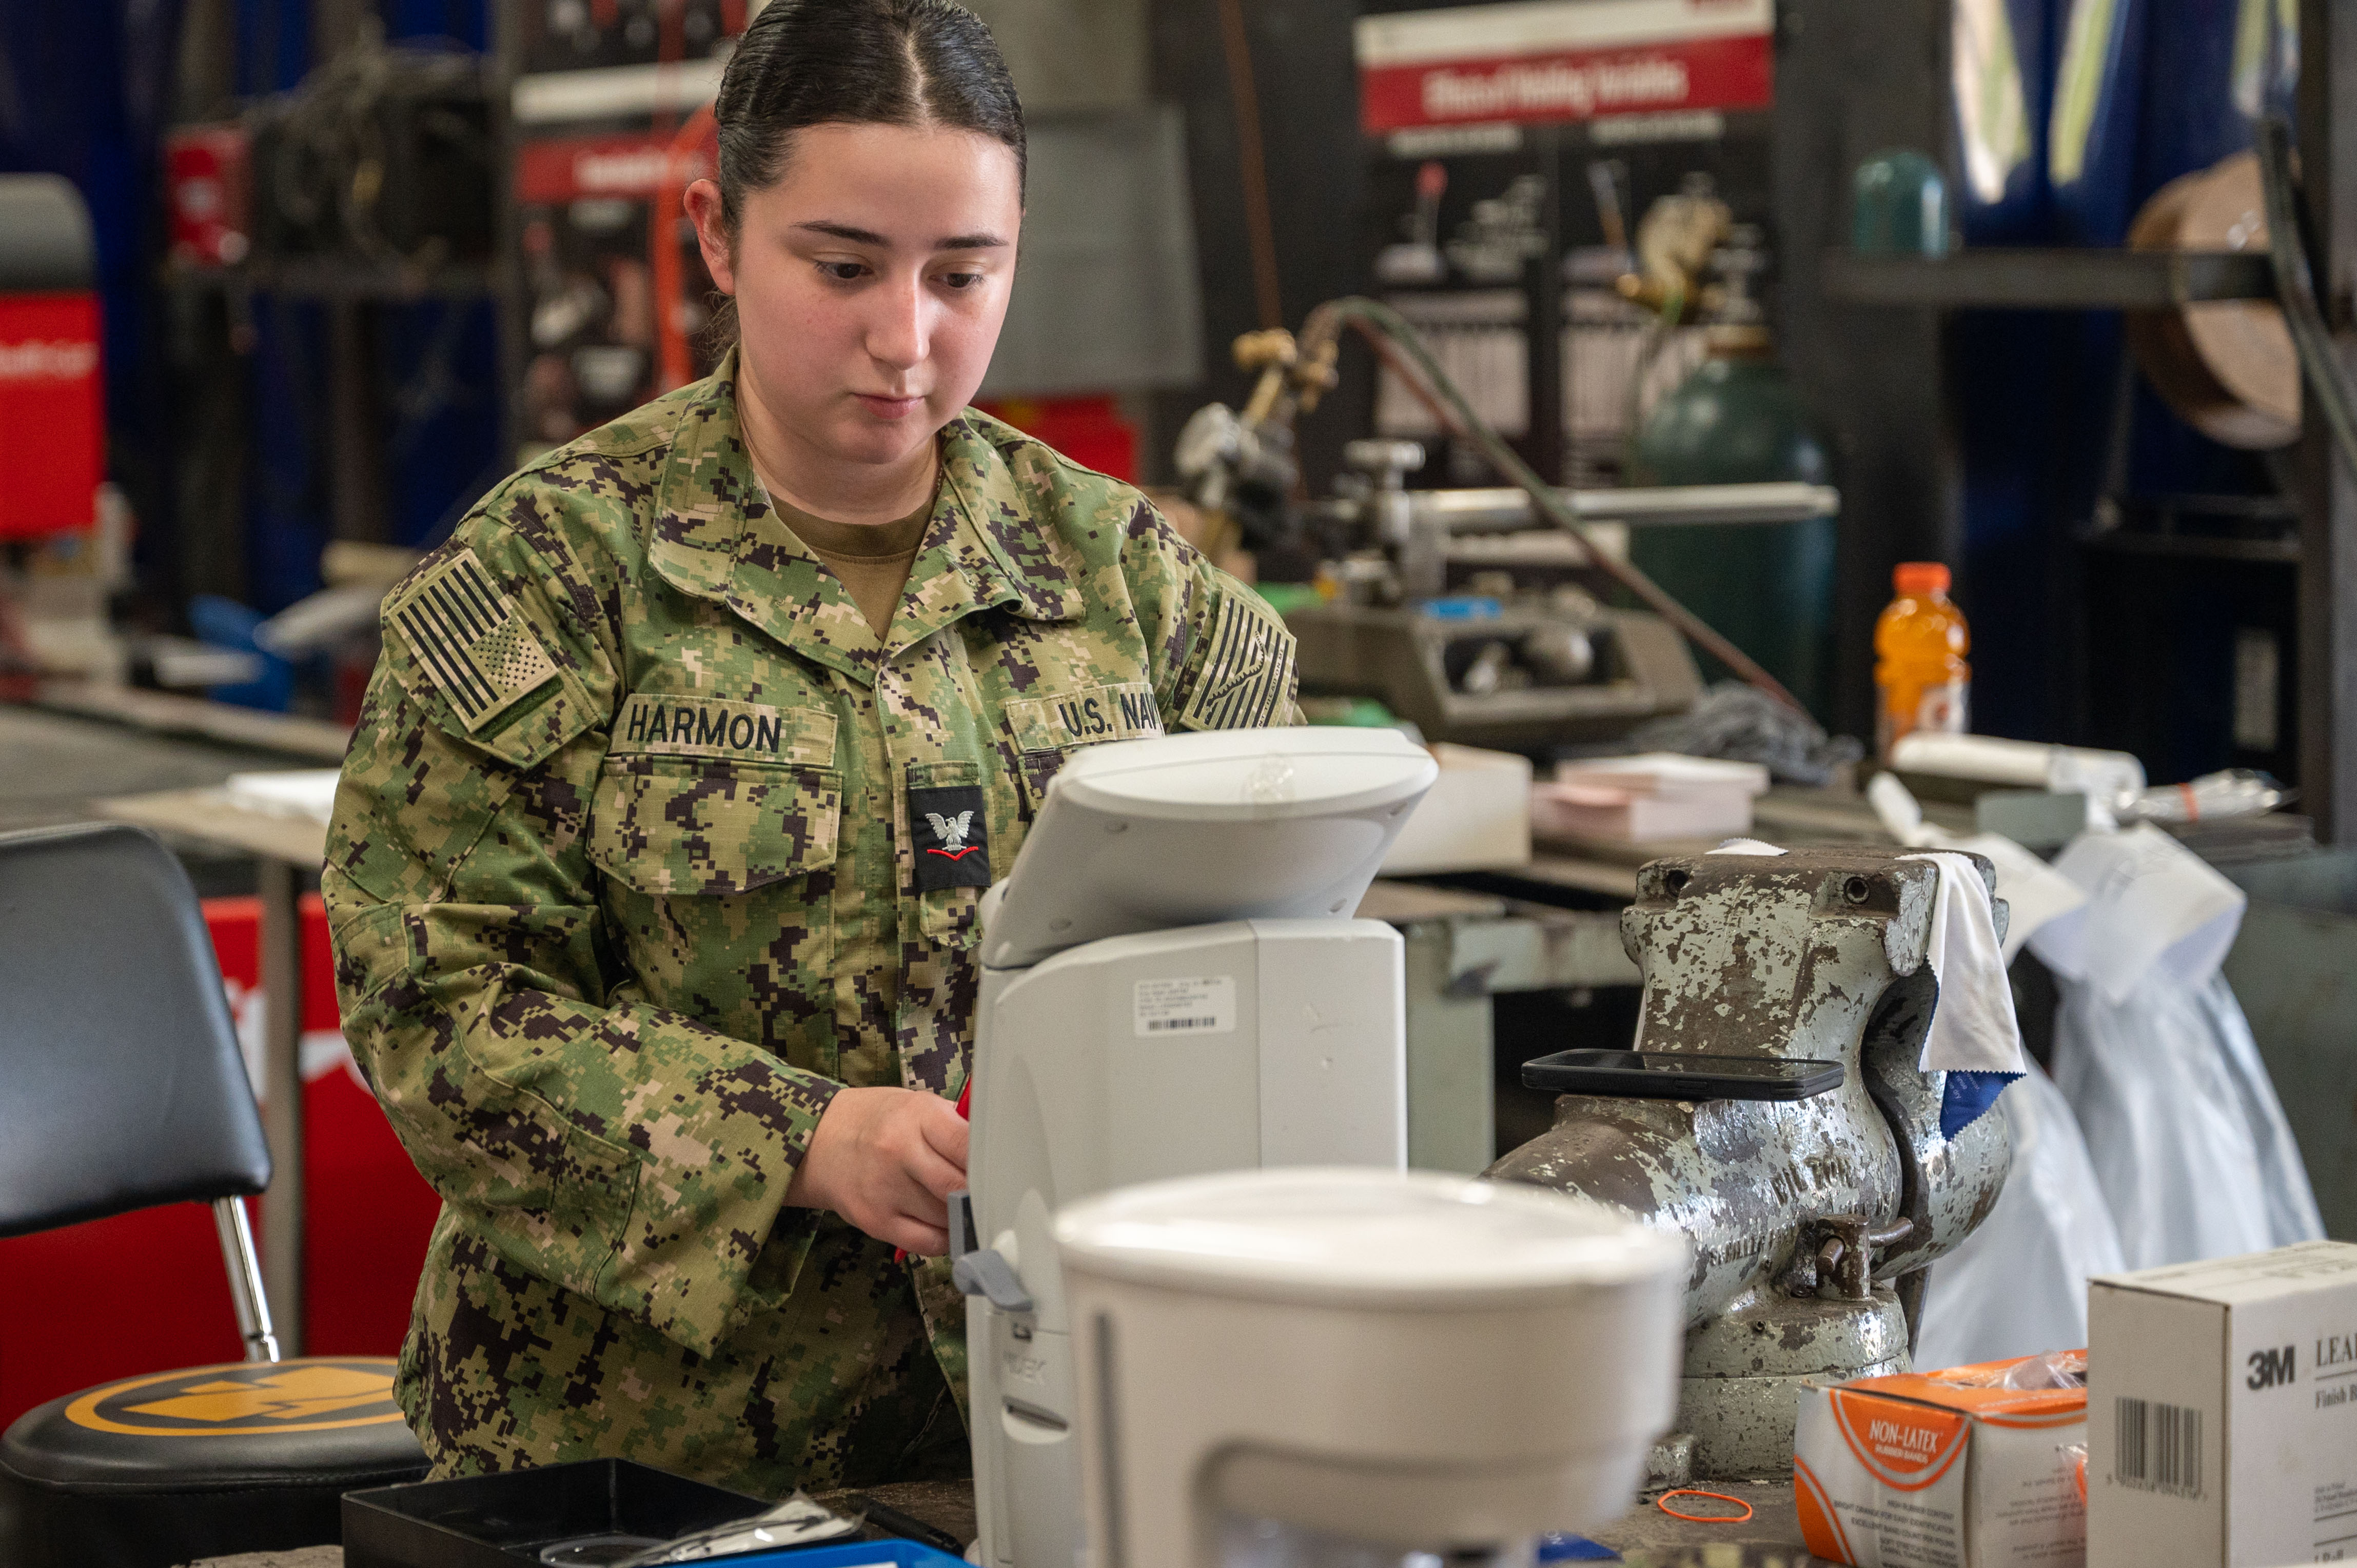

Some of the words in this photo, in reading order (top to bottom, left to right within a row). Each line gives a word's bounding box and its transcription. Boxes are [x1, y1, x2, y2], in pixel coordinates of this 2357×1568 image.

[1275, 662, 1281, 676] ON
[1279, 648, 1284, 661] ME
[627, 704, 781, 753] HARMON
[1058, 698, 1113, 737] U.S.
[1953, 1088, 1961, 1099] dry
[2316, 1333, 2357, 1366] LEA
[2247, 1345, 2294, 1391] 3M
[1869, 1419, 1938, 1453] NON-LATEX
